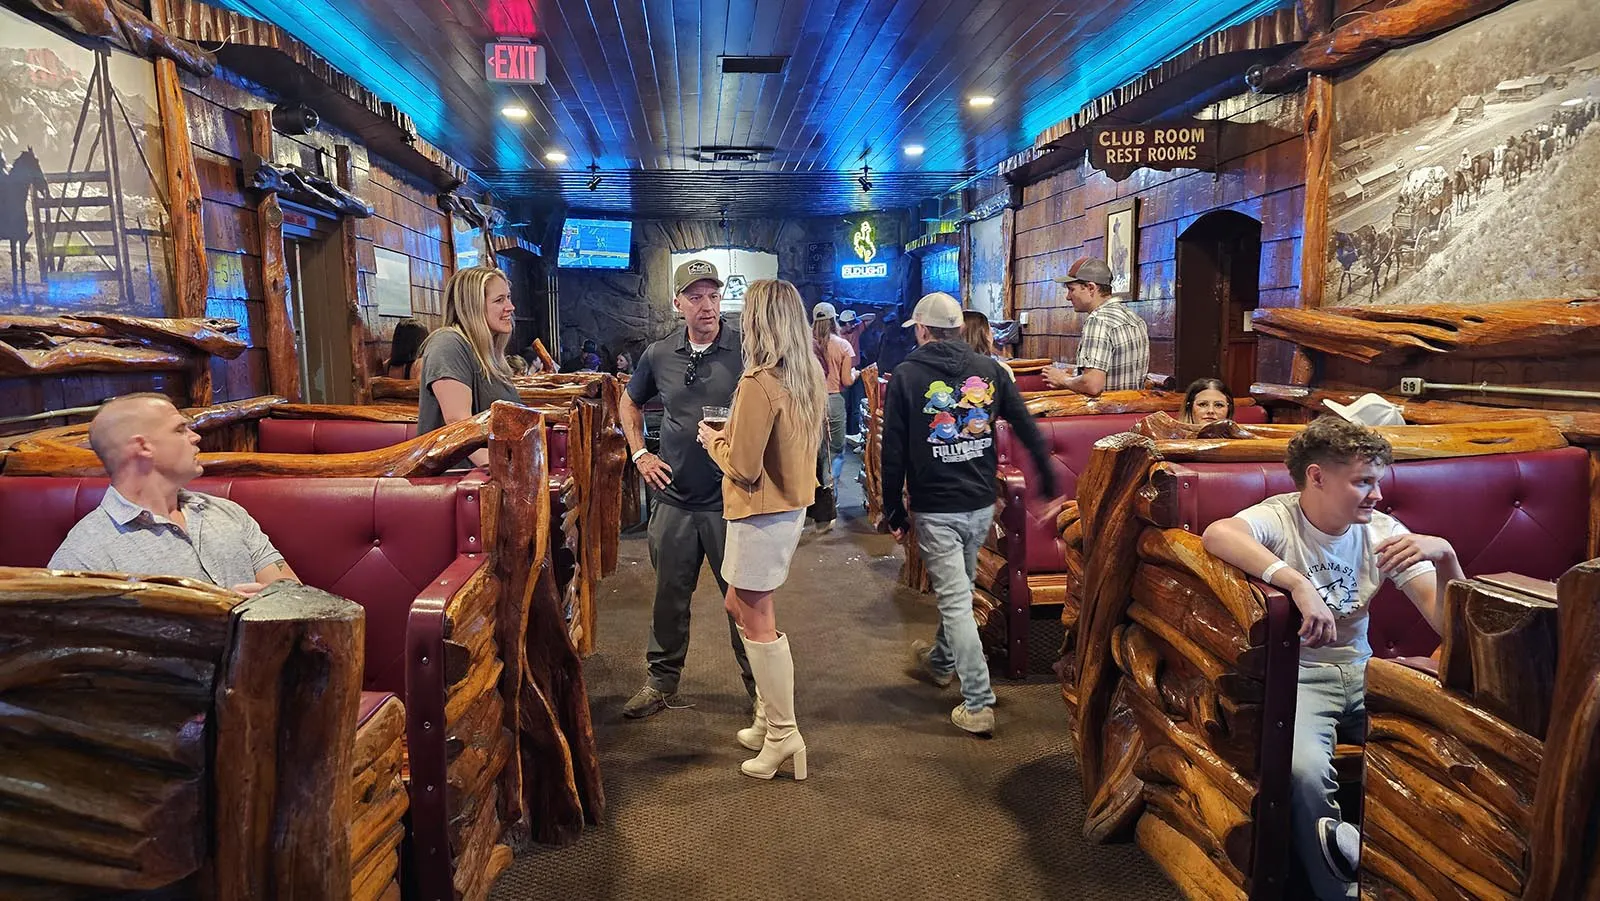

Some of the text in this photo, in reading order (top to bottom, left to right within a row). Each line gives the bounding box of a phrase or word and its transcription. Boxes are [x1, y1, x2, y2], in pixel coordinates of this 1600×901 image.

[494, 44, 537, 80] EXIT
[1099, 127, 1205, 147] CLUB ROOM
[1106, 145, 1197, 164] REST ROOMS
[1303, 562, 1341, 580] TANA
